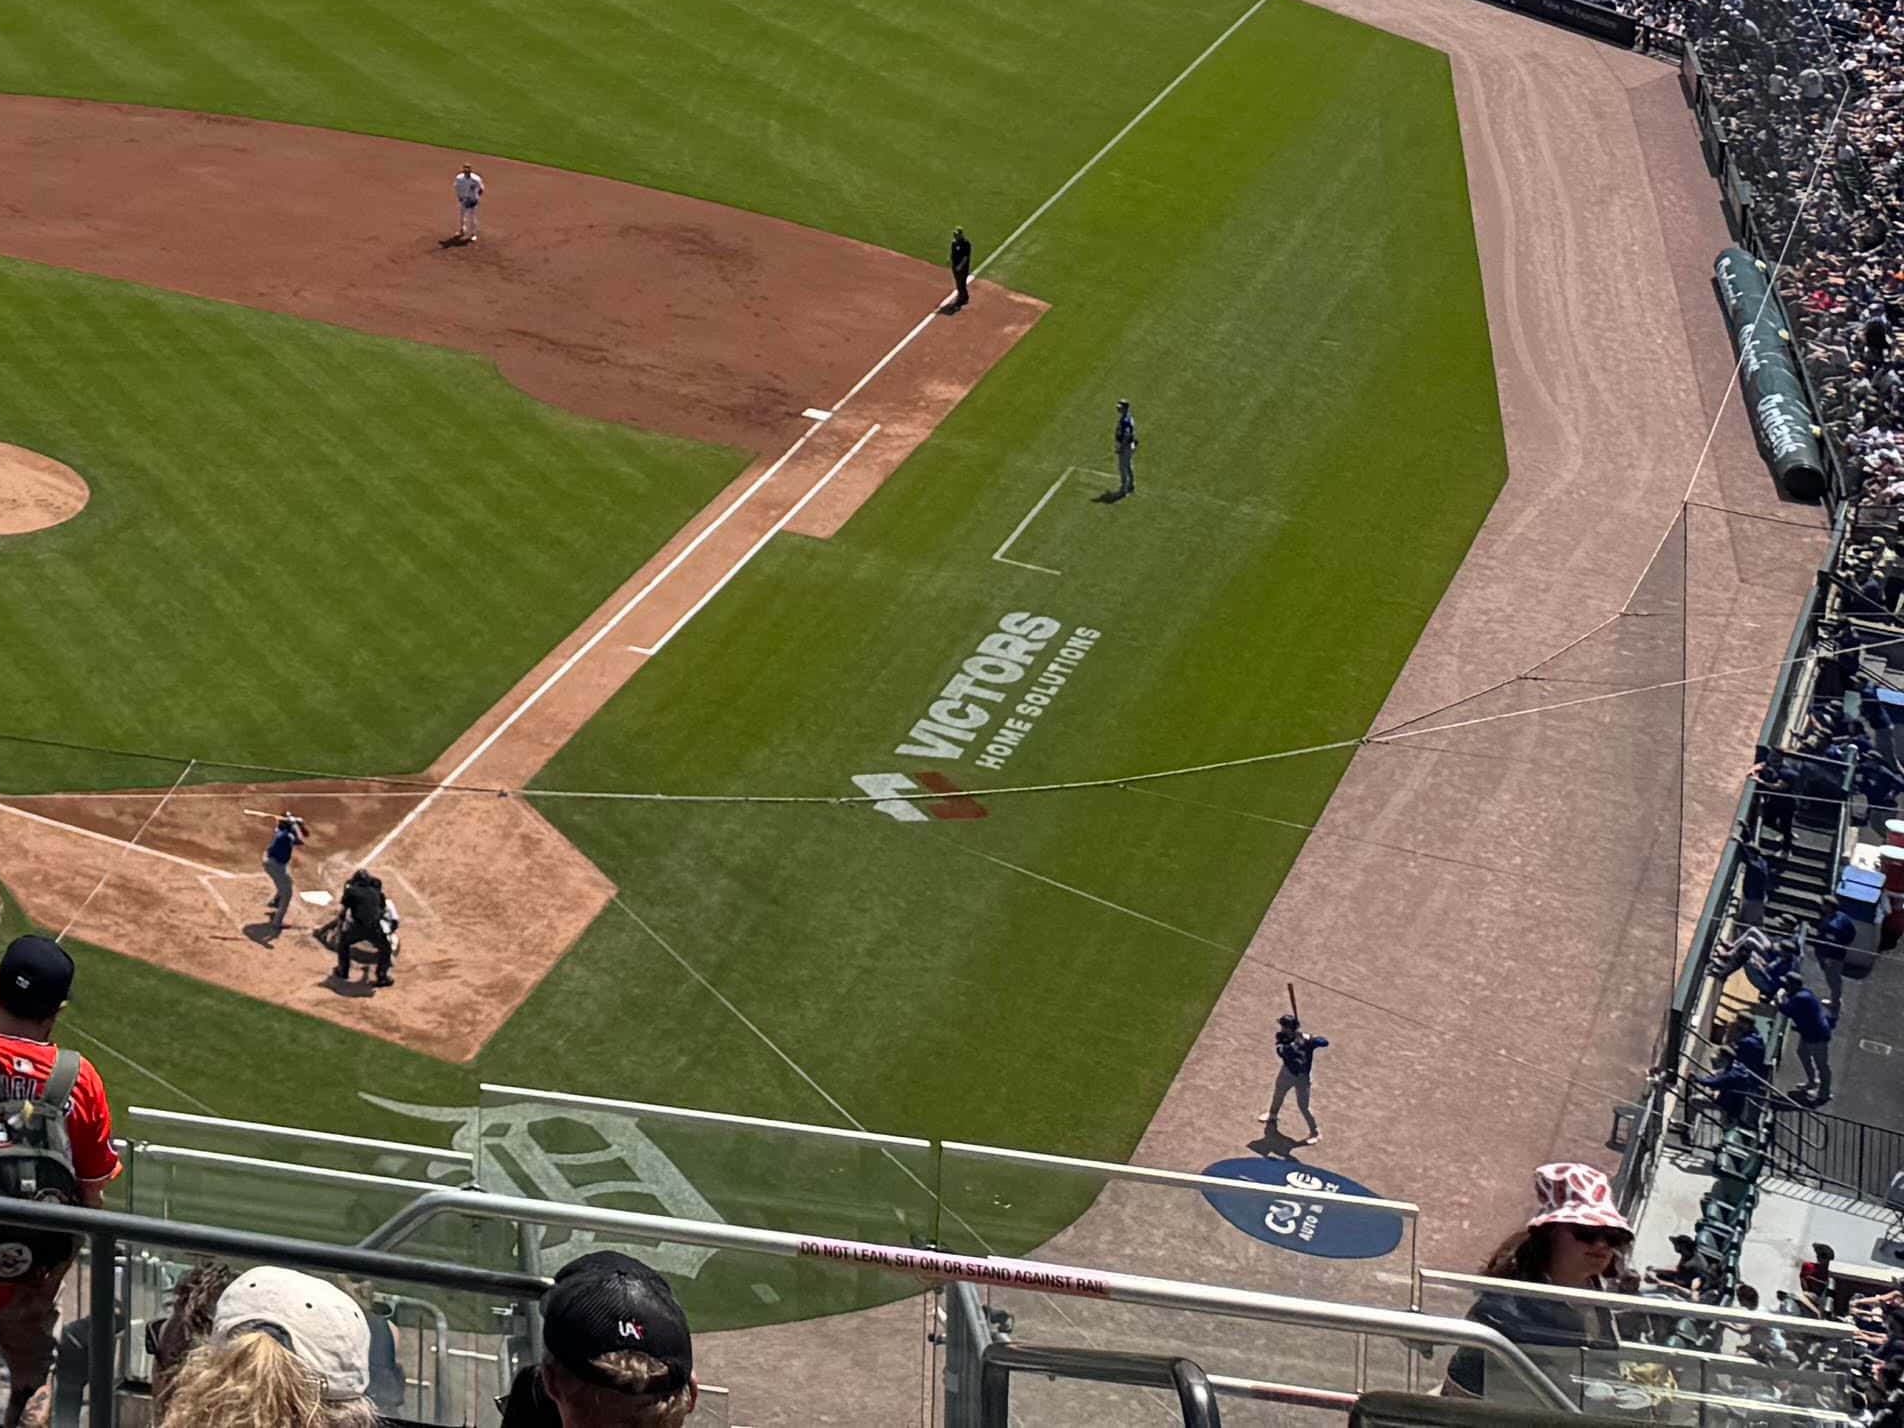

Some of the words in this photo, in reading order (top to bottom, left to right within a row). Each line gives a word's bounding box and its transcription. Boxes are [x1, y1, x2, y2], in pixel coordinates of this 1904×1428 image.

[894, 611, 1061, 760] VICTORS
[975, 717, 1033, 770] HOME
[1016, 625, 1102, 717] SOLUTIONS
[801, 1241, 819, 1256] DO
[824, 1244, 849, 1260] NOT
[854, 1248, 890, 1265] LEAN,
[895, 1254, 916, 1268] SIT
[920, 1256, 940, 1271] ON
[944, 1260, 962, 1274] OR
[966, 1263, 1011, 1281] STAND
[1014, 1270, 1074, 1288] AGAINST
[1077, 1277, 1106, 1293] RAIL
